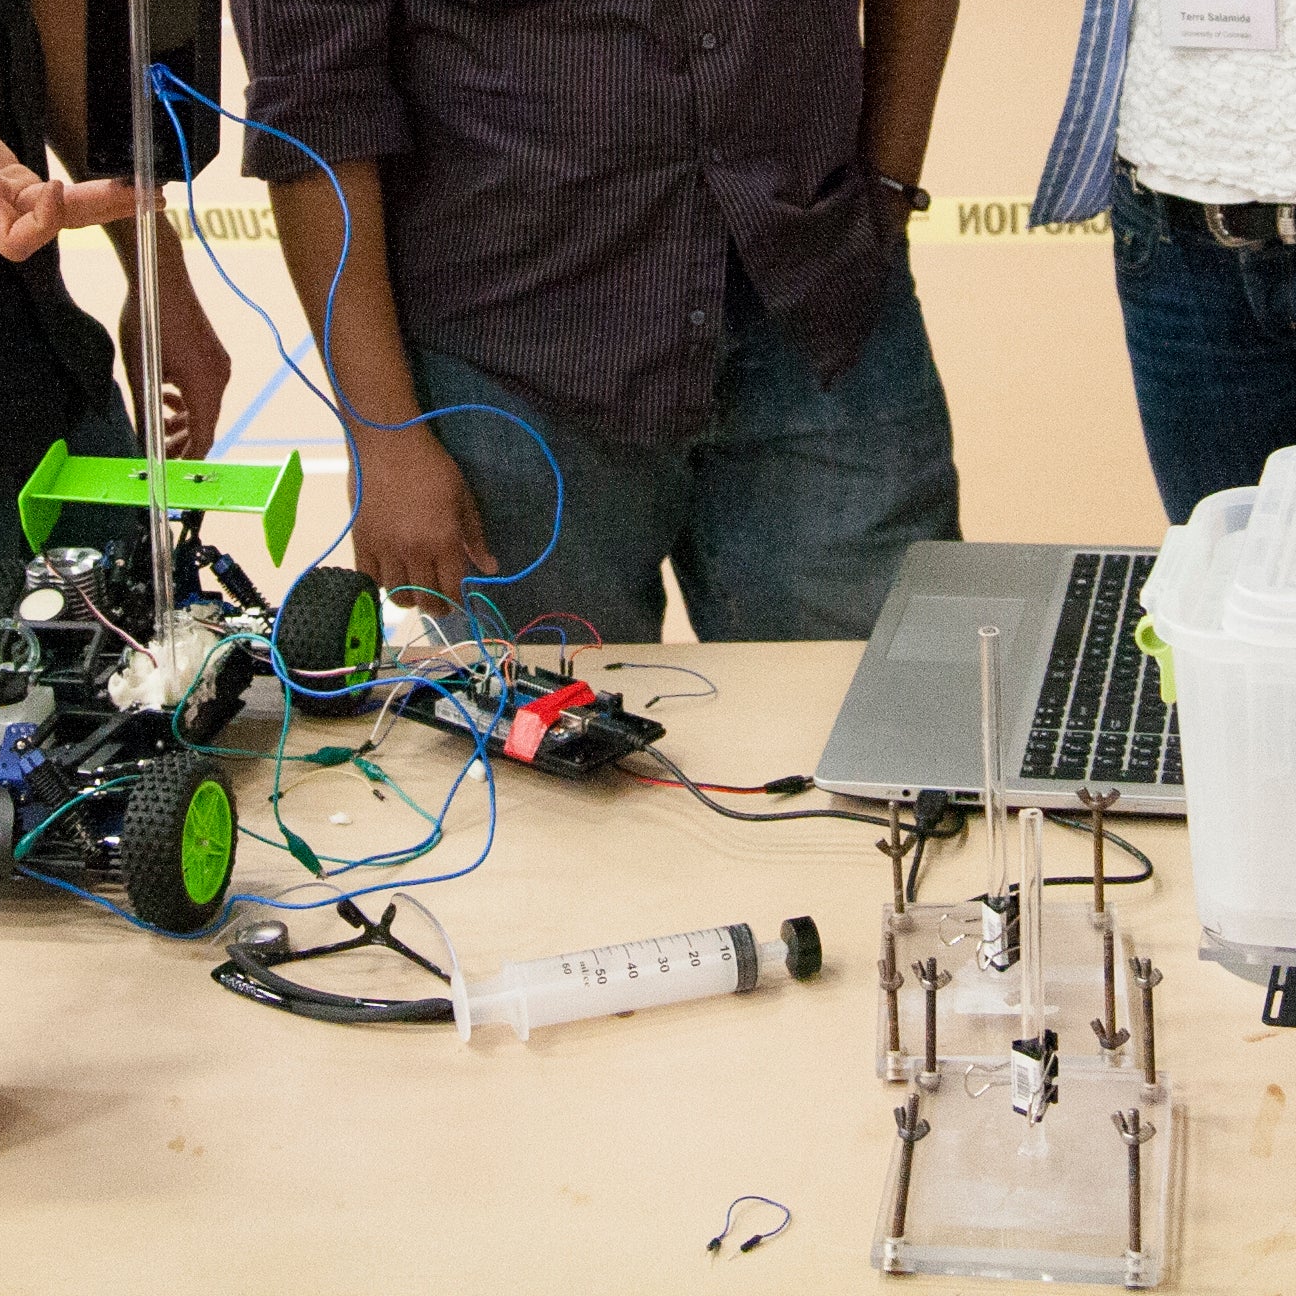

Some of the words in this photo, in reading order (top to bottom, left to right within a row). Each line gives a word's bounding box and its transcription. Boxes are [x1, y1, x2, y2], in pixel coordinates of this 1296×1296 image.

[688, 950, 702, 968] 20
[720, 945, 732, 962] 10
[561, 962, 572, 976] 60
[626, 961, 639, 980] 40
[657, 956, 671, 974] 30
[595, 968, 608, 986] 50
